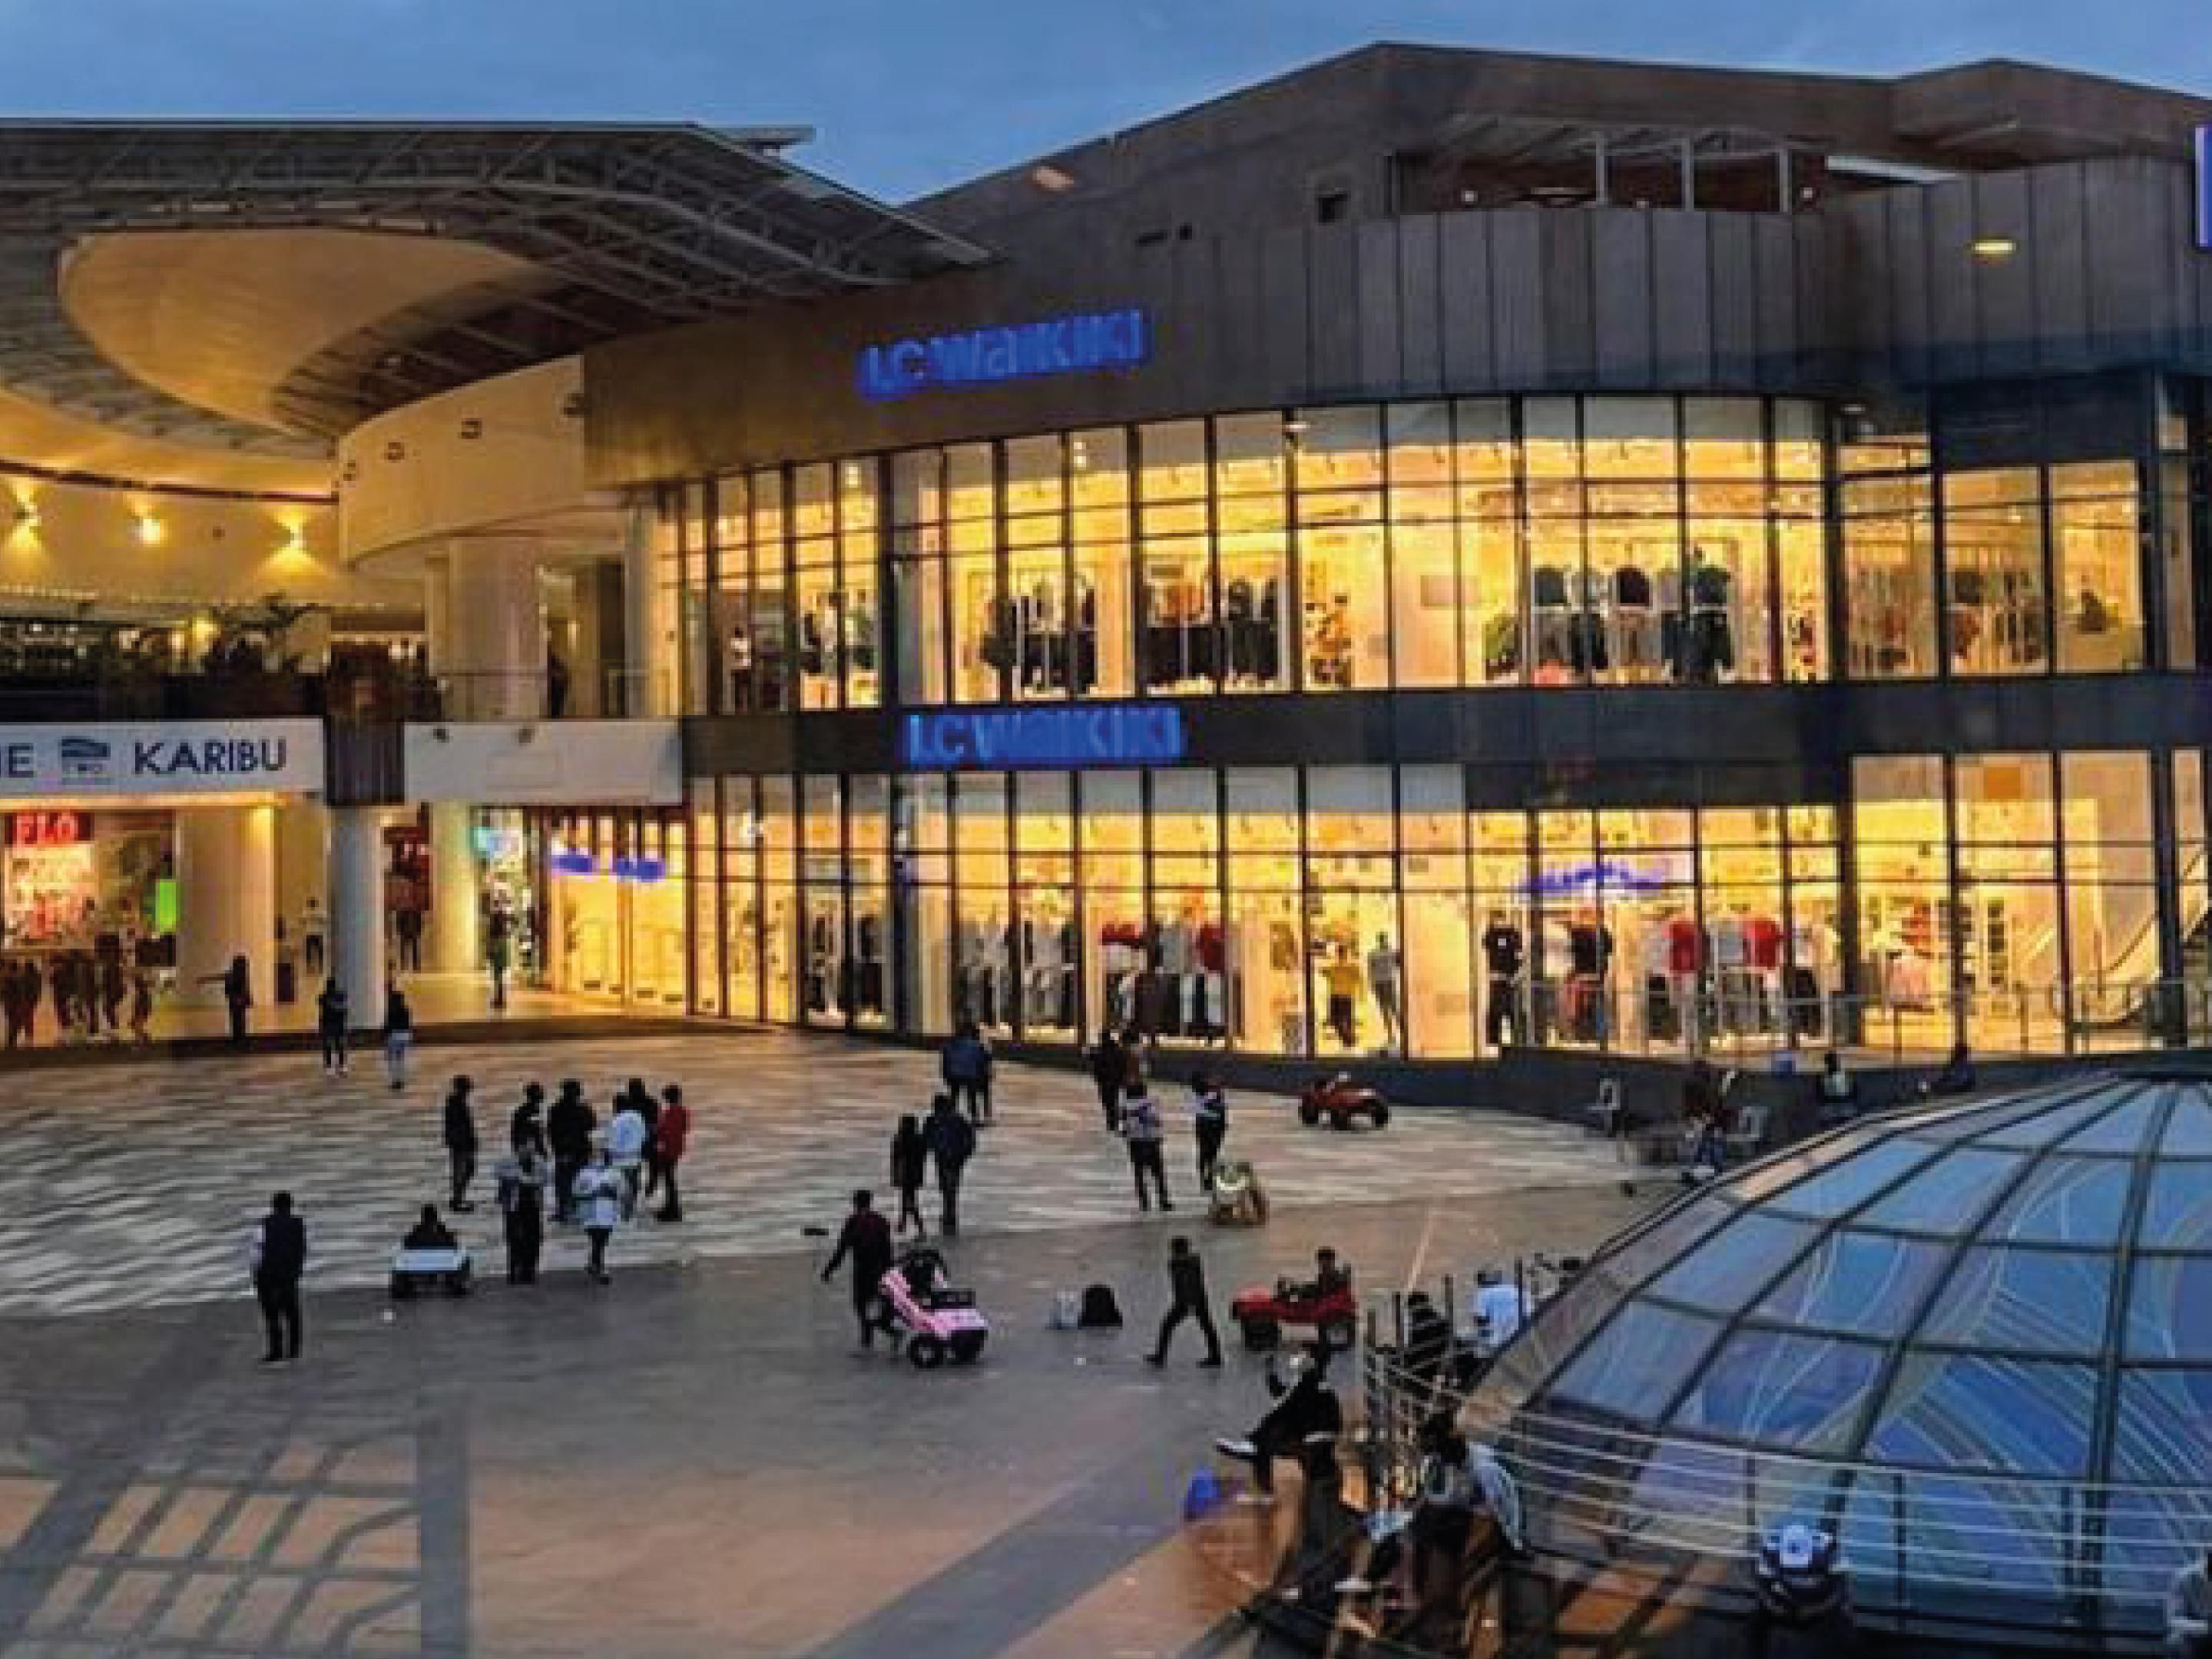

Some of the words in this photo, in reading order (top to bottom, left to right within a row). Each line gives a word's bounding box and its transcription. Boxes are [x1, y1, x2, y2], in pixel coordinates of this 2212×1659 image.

[865, 338, 924, 392] LC
[0, 743, 34, 777] E
[134, 739, 286, 775] KARIBU
[908, 713, 965, 764] LC
[15, 813, 75, 846] FLO
